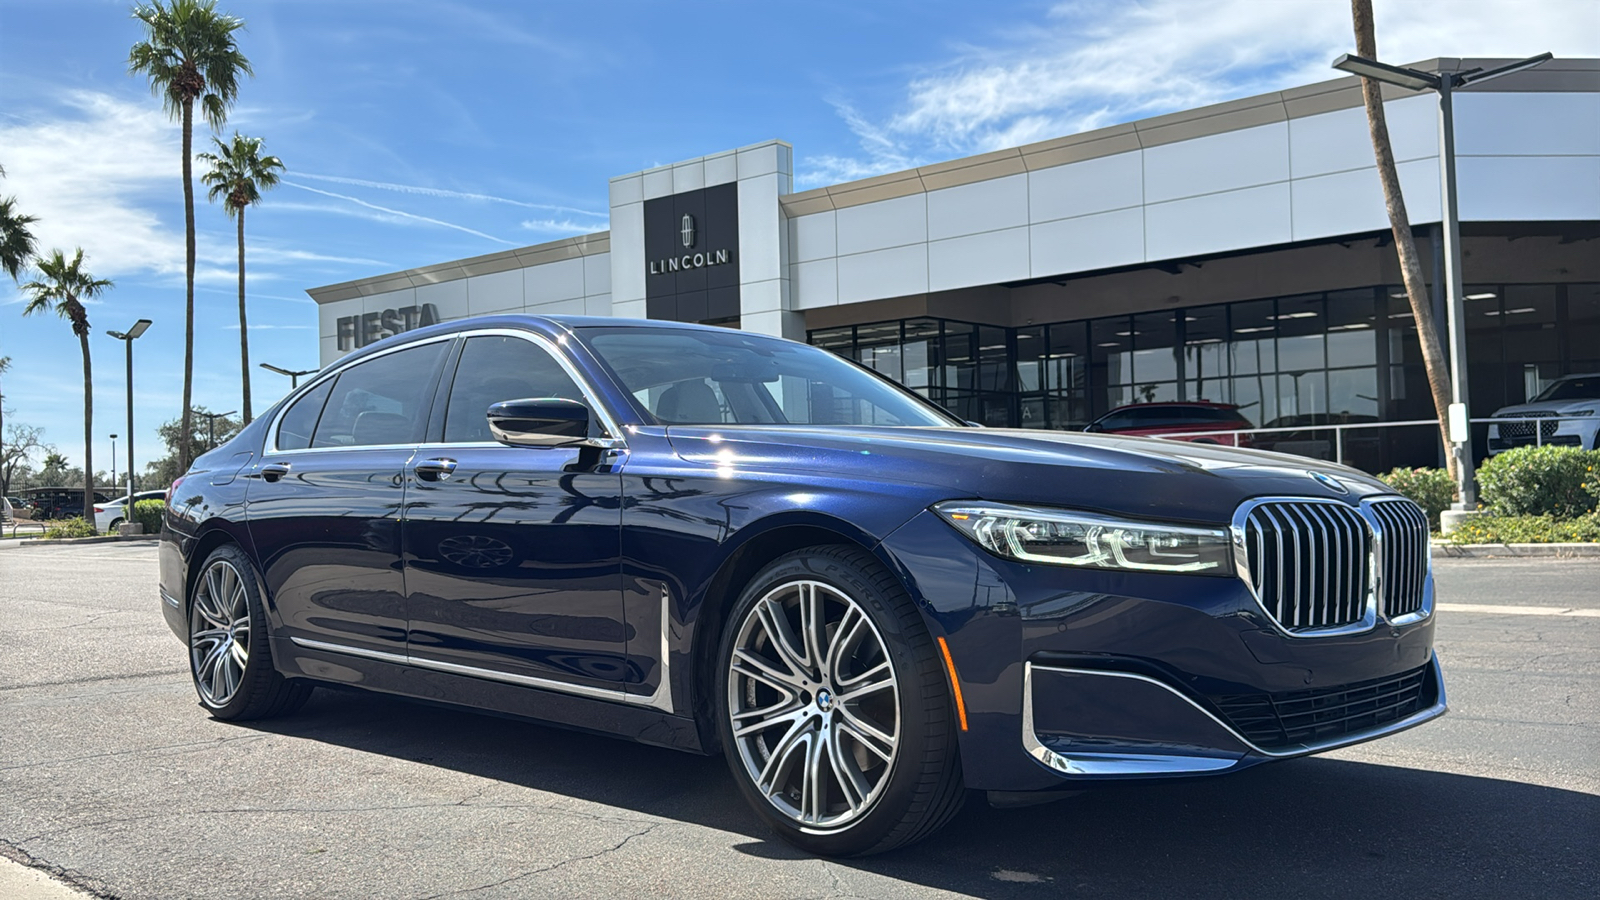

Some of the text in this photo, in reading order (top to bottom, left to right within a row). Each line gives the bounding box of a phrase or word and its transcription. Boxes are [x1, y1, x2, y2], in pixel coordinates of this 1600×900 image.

[650, 249, 729, 275] LINCOLN
[337, 303, 440, 351] FIESTA
[839, 571, 885, 611] ZERO
